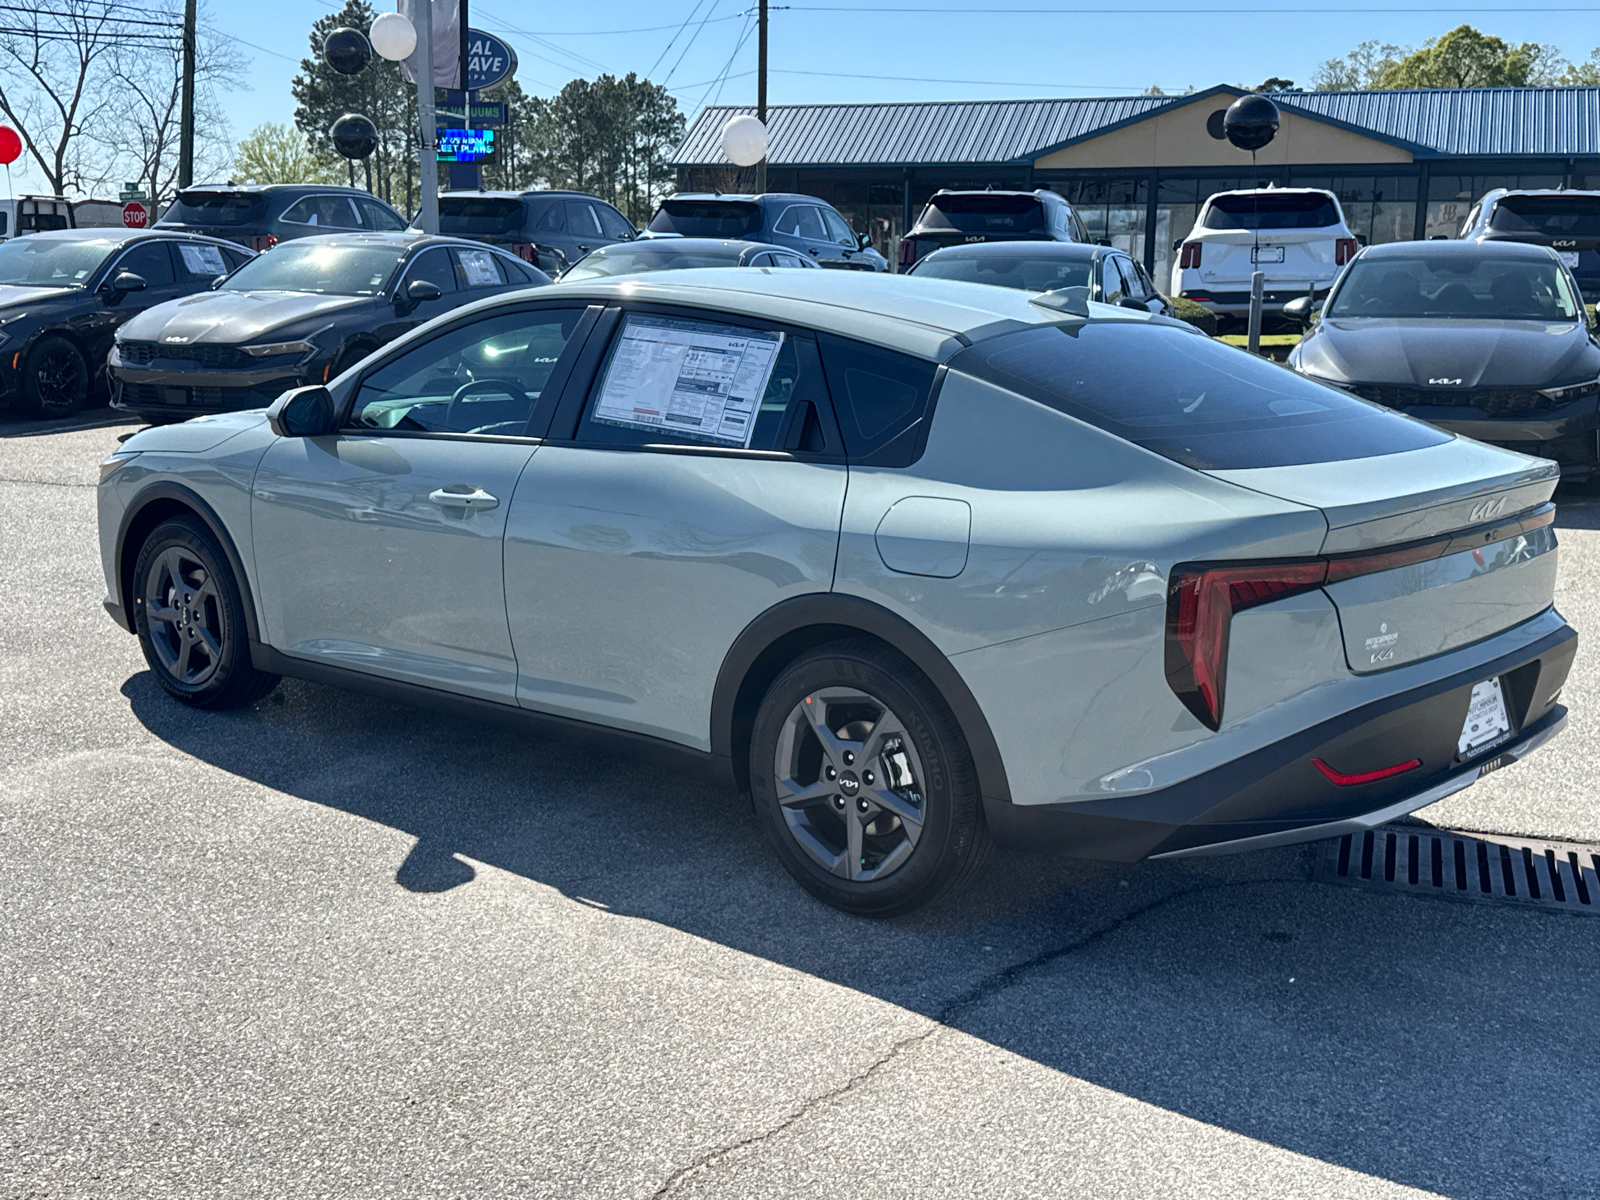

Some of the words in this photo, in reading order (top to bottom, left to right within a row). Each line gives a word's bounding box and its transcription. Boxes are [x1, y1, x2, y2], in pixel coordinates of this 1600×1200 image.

[468, 56, 503, 72] AVE
[124, 211, 146, 223] STOP
[689, 352, 700, 361] 33
[1467, 496, 1507, 522] KIA
[1370, 648, 1394, 664] K4
[908, 709, 943, 791] KUMHO
